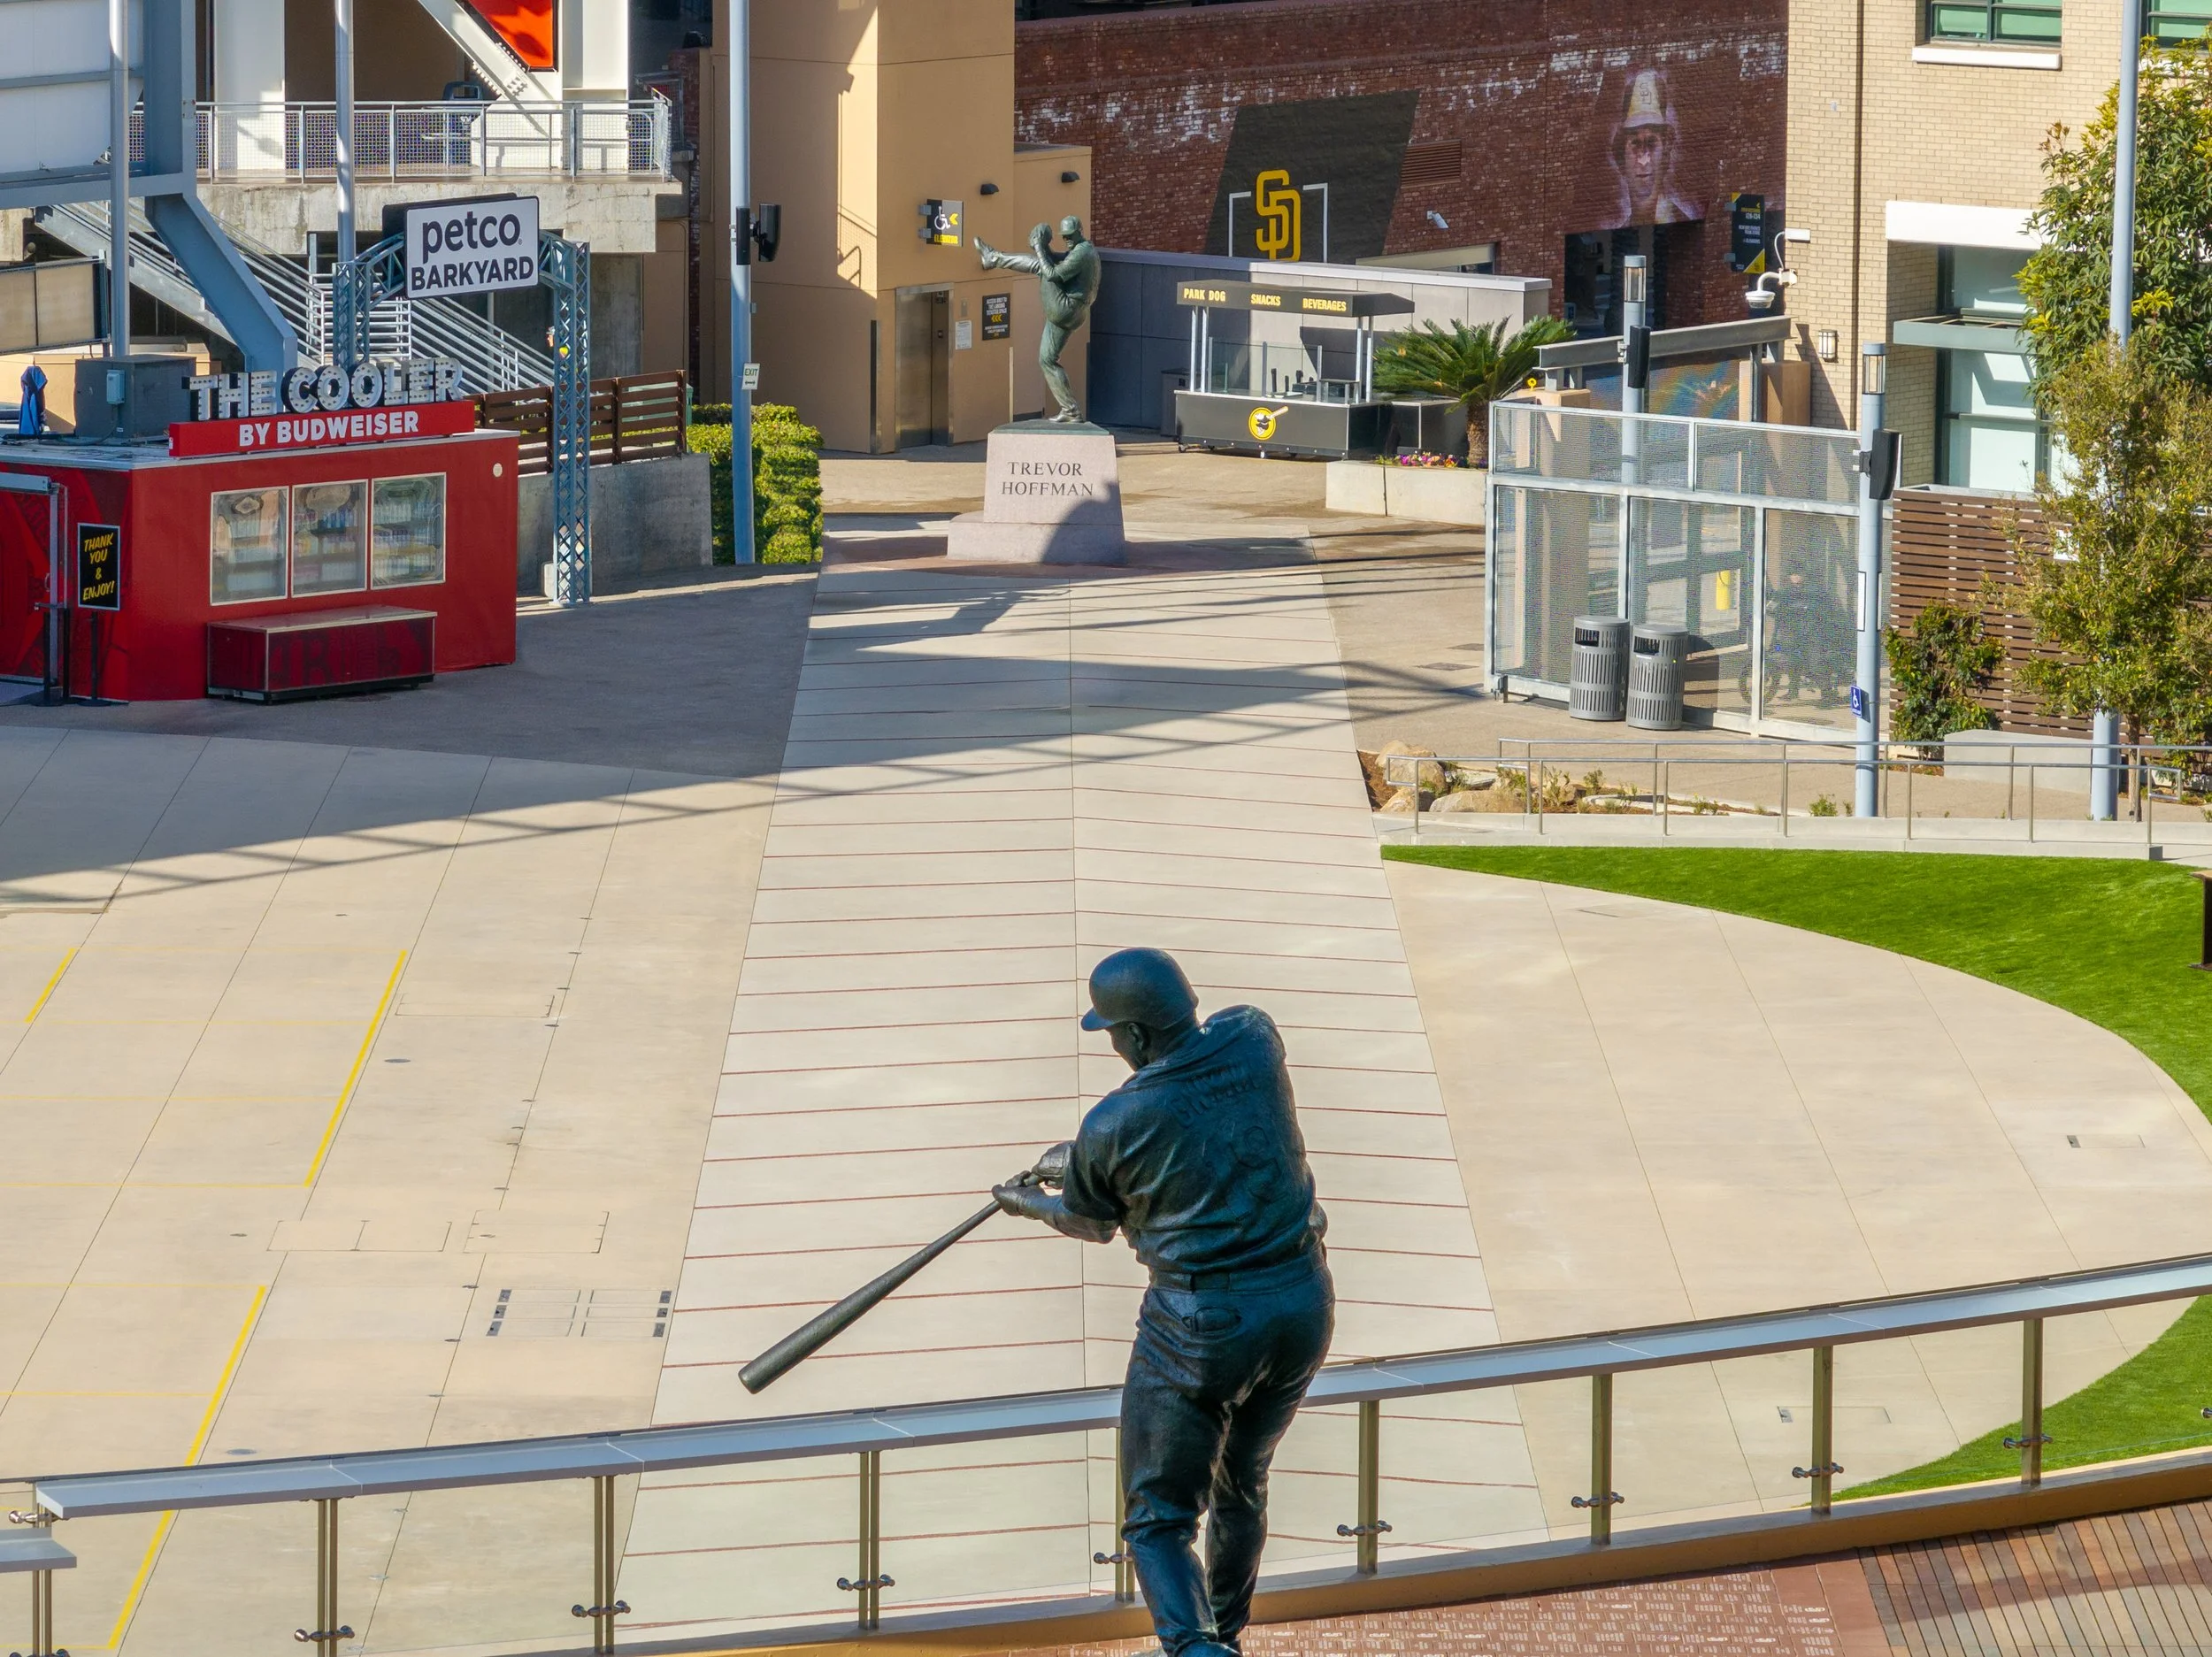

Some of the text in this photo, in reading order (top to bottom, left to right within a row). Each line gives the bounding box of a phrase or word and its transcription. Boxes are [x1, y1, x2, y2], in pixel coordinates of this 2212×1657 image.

[422, 211, 521, 264] petco
[411, 256, 534, 290] BARKYARD
[1184, 288, 1226, 302] PARK DOG
[1250, 293, 1281, 306] SNACKS
[1302, 297, 1347, 311] BEVERAGES
[745, 368, 758, 377] EXIT
[184, 357, 464, 421] THE COOLER
[239, 410, 419, 447] BY BUDWEISER
[1008, 461, 1083, 476] TREVOR
[1001, 481, 1094, 496] HOFFMAN
[84, 533, 114, 553] THANK
[89, 548, 108, 564] YOU
[95, 567, 103, 580] &
[82, 580, 115, 601] ENJOY!
